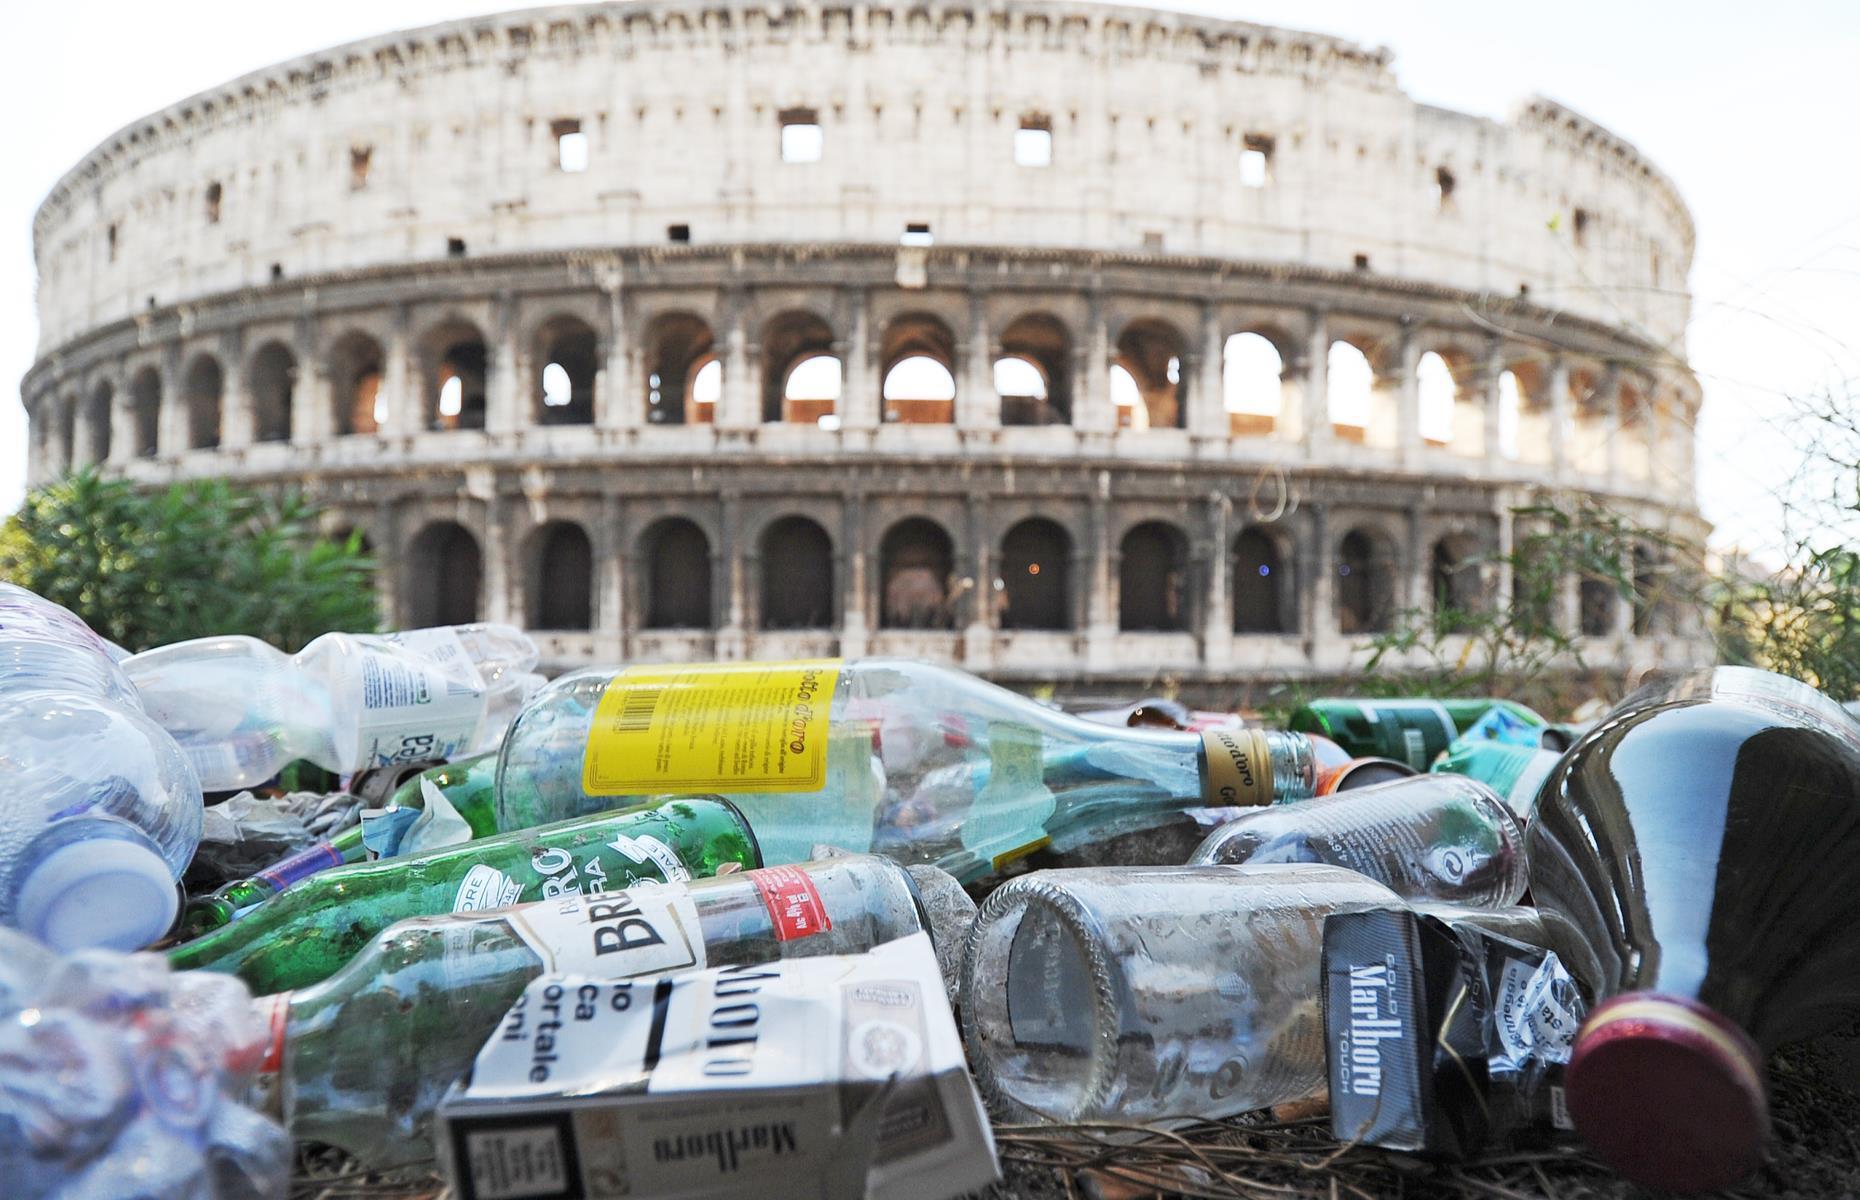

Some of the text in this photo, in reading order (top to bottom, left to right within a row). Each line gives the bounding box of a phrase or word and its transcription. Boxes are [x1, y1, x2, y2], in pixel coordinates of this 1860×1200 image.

[532, 847, 584, 901] RO
[584, 855, 608, 895] RA
[645, 843, 685, 882] INALE
[460, 876, 484, 913] ORE
[590, 890, 667, 957] BRE
[574, 983, 599, 1022] ca
[1386, 953, 1398, 1015] GOLD
[528, 983, 564, 1083] ortale
[1350, 964, 1403, 1096] Marlboro
[1339, 1028, 1350, 1094] TOUCH
